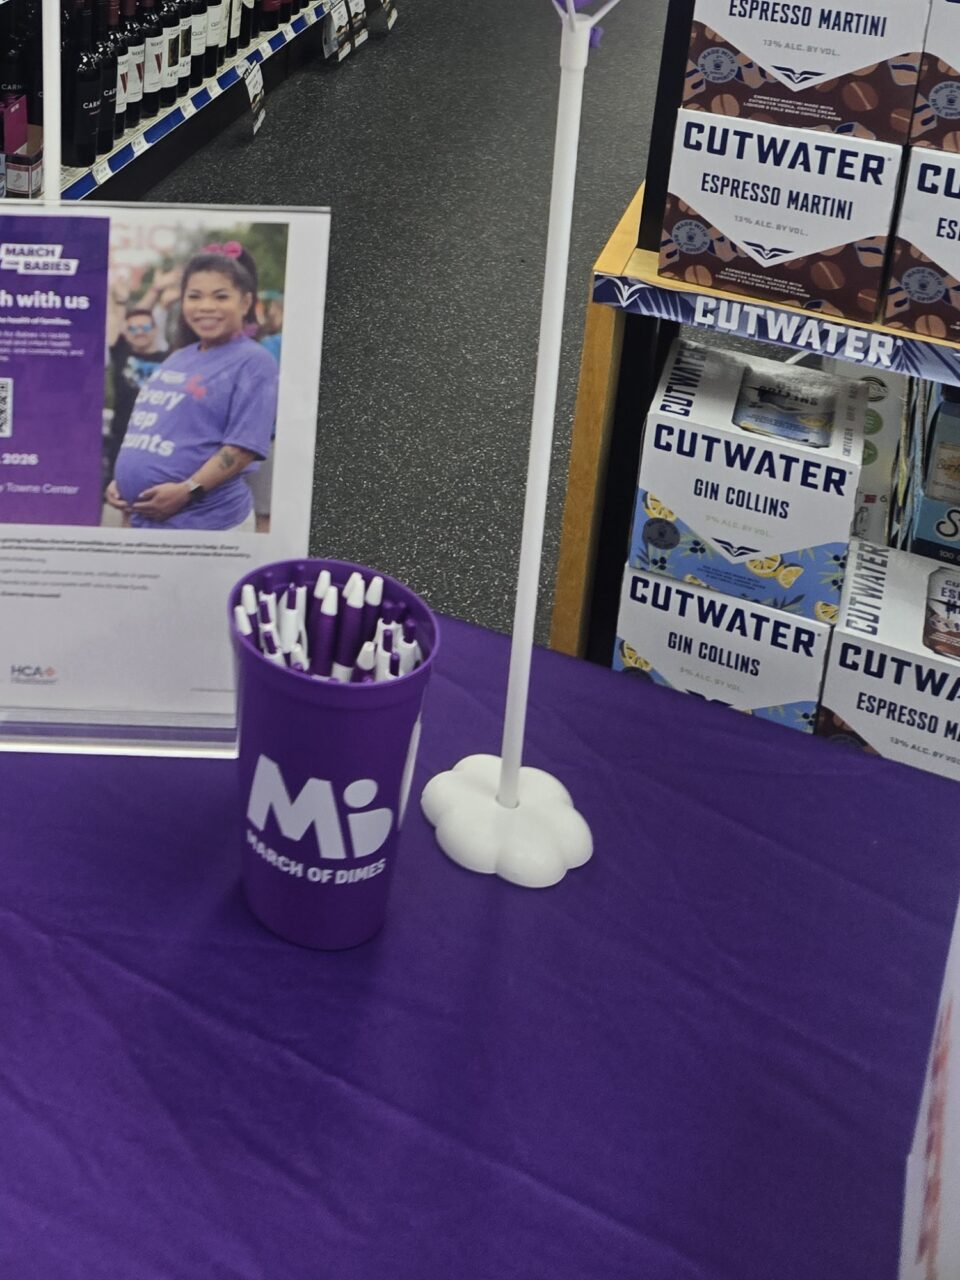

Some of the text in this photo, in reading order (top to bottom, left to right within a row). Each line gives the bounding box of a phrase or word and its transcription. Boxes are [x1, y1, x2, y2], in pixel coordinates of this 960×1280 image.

[819, 8, 887, 38] MARTINI
[784, 43, 804, 52] ALC.
[807, 45, 818, 53] BY
[683, 122, 886, 186] CUTWATER
[701, 172, 853, 220] ESPRESSO MARTINI
[5, 247, 55, 257] MARCH
[24, 261, 71, 271] BABIES
[17, 291, 61, 309] with
[64, 295, 90, 310] us
[693, 296, 893, 367] CUTWATER
[653, 423, 848, 496] CUTWATER
[6, 483, 40, 493] Towne
[42, 484, 79, 495] Center
[693, 478, 790, 519] GIN COLLINS
[846, 544, 890, 636] CUTWATER
[631, 576, 816, 658] CUTWATER
[11, 666, 43, 677] HCA
[668, 631, 760, 677] GIN COLLINS
[856, 692, 940, 734] ESPRESSO
[246, 828, 387, 885] MARCH OF DIMES
